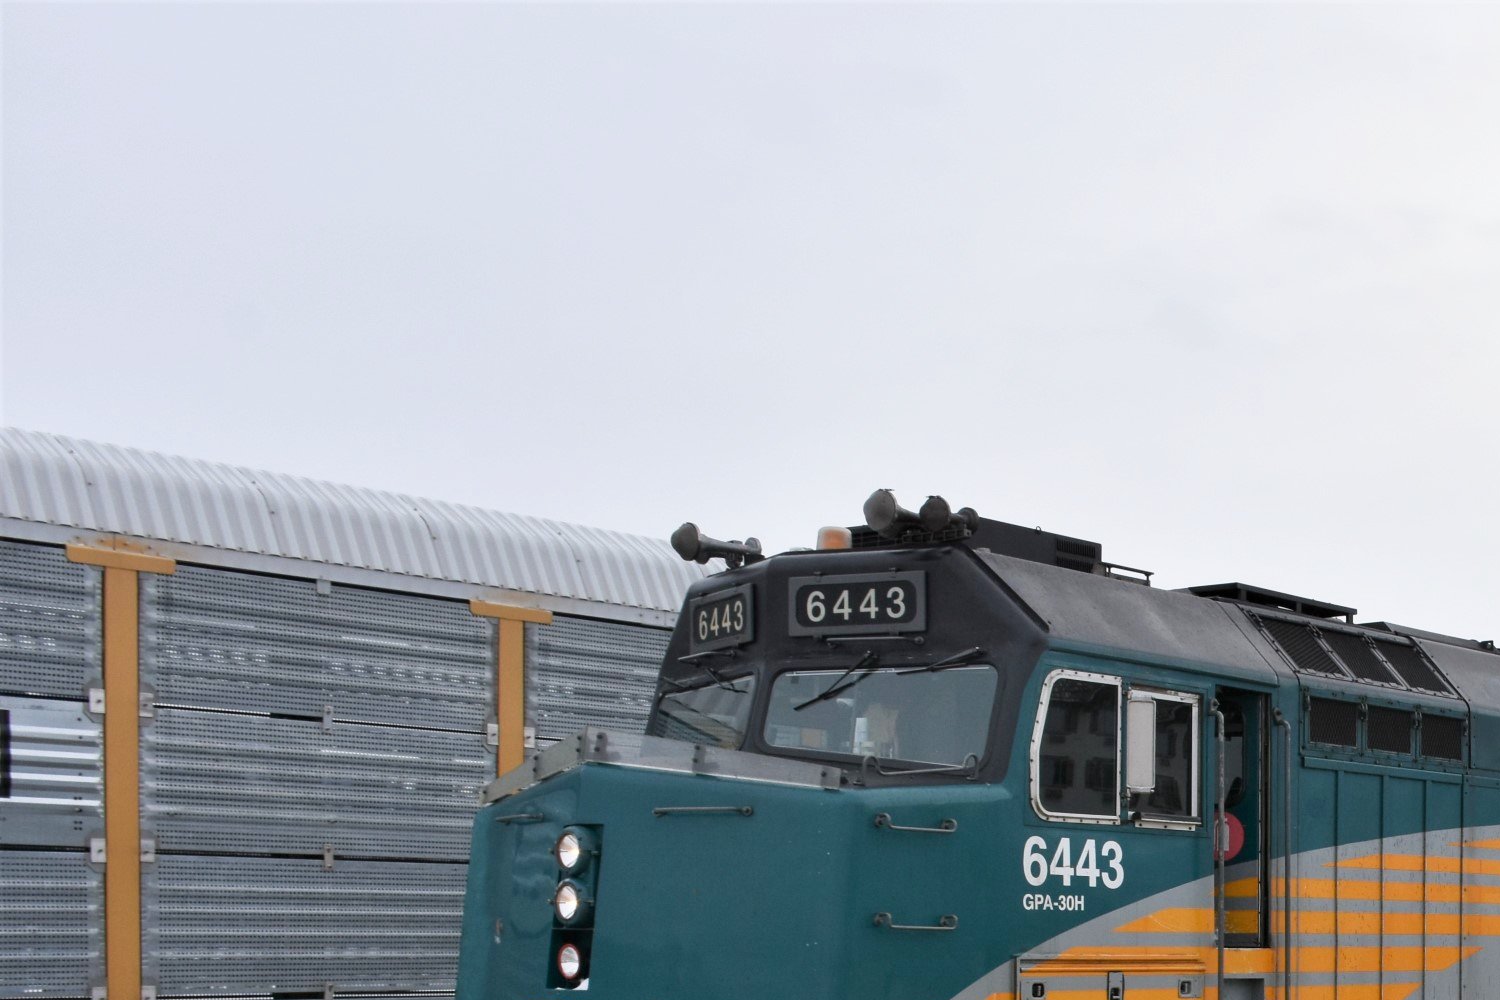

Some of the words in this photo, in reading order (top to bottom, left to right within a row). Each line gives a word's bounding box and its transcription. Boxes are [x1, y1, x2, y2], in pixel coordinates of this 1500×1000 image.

[698, 600, 745, 641] 6443
[806, 586, 906, 623] 6443
[1022, 835, 1125, 890] 6443
[1022, 893, 1085, 912] GPA-30H
